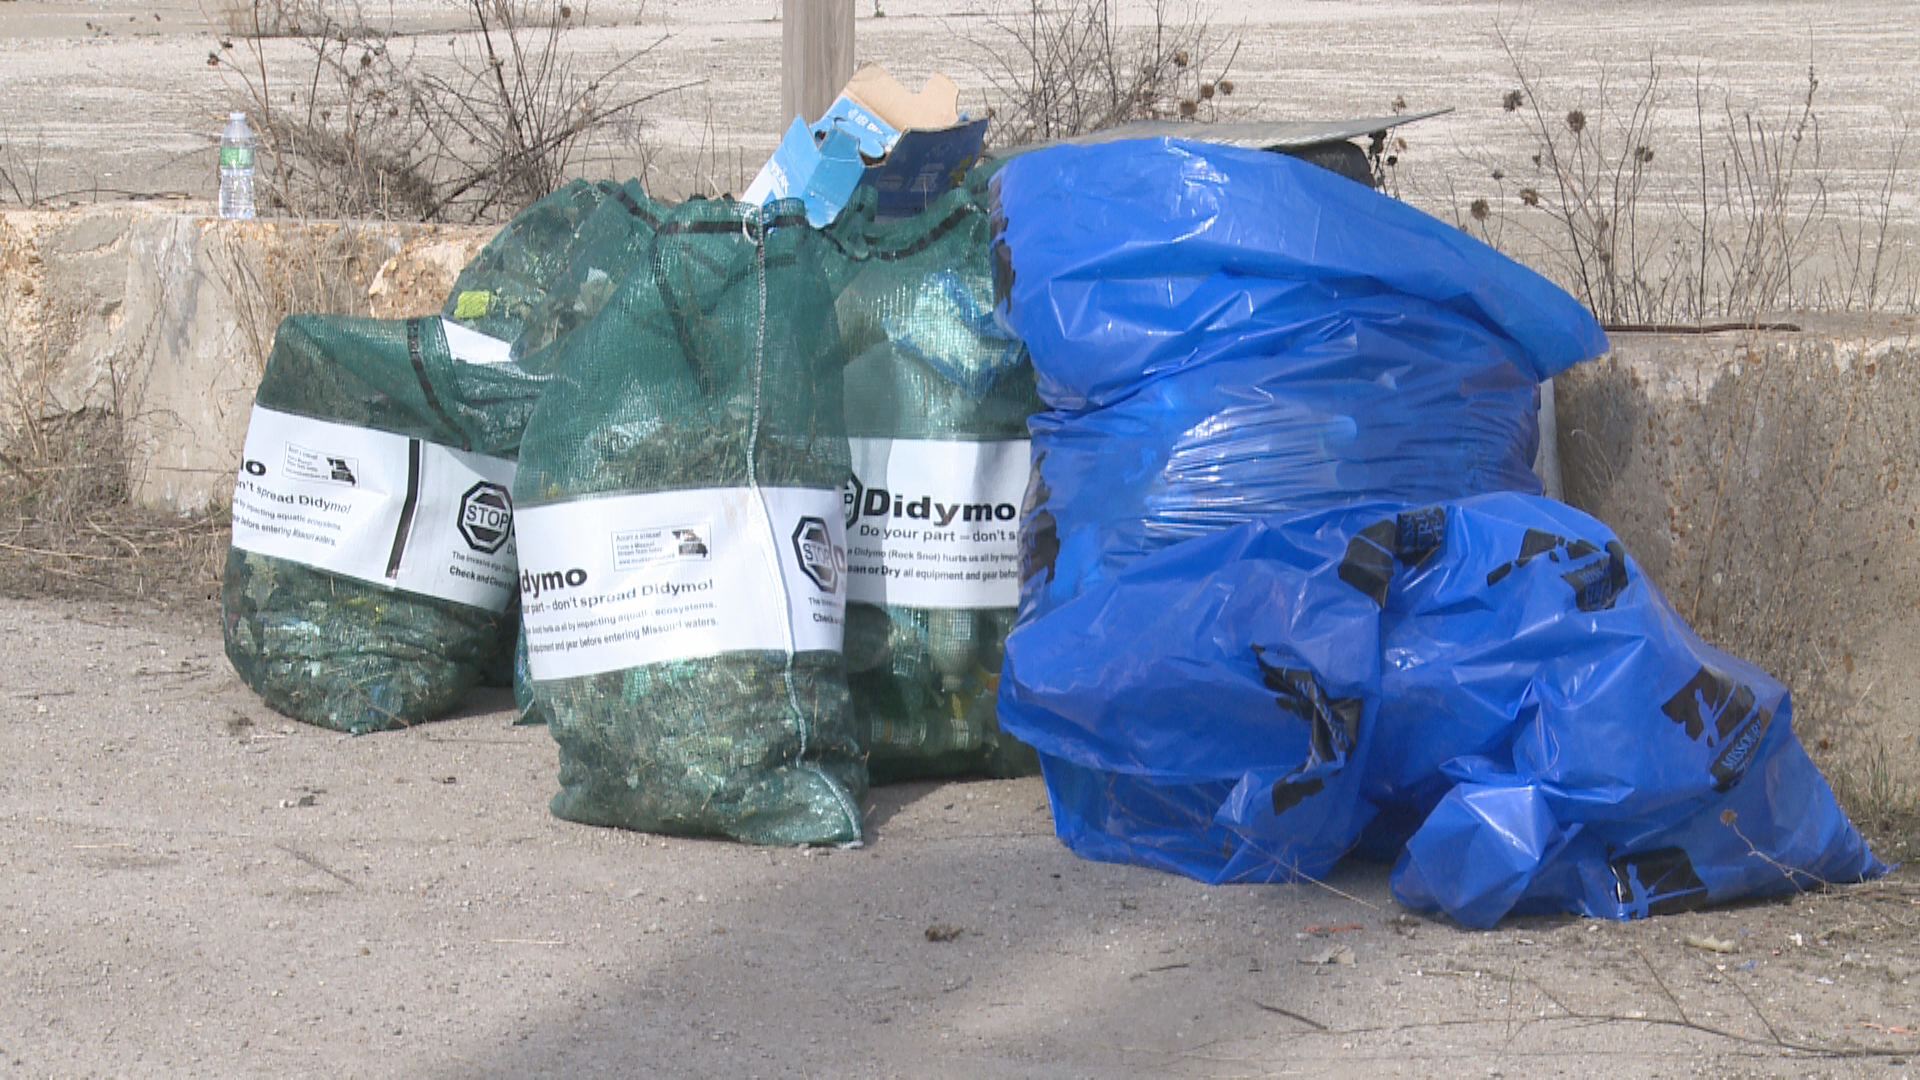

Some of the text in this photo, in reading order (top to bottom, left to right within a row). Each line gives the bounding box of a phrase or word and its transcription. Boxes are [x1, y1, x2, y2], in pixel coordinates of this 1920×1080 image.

[257, 486, 294, 504] spread
[298, 495, 352, 514] Didymo!
[863, 489, 1016, 527] Didymo
[466, 505, 509, 528] STOP
[860, 525, 880, 536] Do
[883, 527, 918, 540] your
[923, 530, 955, 543] part
[972, 529, 1005, 542] don't
[854, 547, 886, 558] Didymo
[888, 549, 914, 560] (Rock
[943, 552, 967, 562] hurts
[980, 553, 989, 562] all
[990, 553, 999, 563] by
[450, 565, 476, 581] Check
[521, 569, 588, 598] dymo
[868, 566, 879, 575] or
[881, 565, 900, 578] Dry
[903, 567, 914, 577] all
[916, 569, 963, 581] equipment
[966, 571, 980, 580] and
[982, 571, 997, 582] gear
[552, 597, 579, 611] don't
[642, 579, 713, 596] Didymo!
[577, 616, 616, 629] impacting
[580, 634, 602, 647] before
[604, 628, 640, 643] entering
[684, 618, 719, 629] waters.
